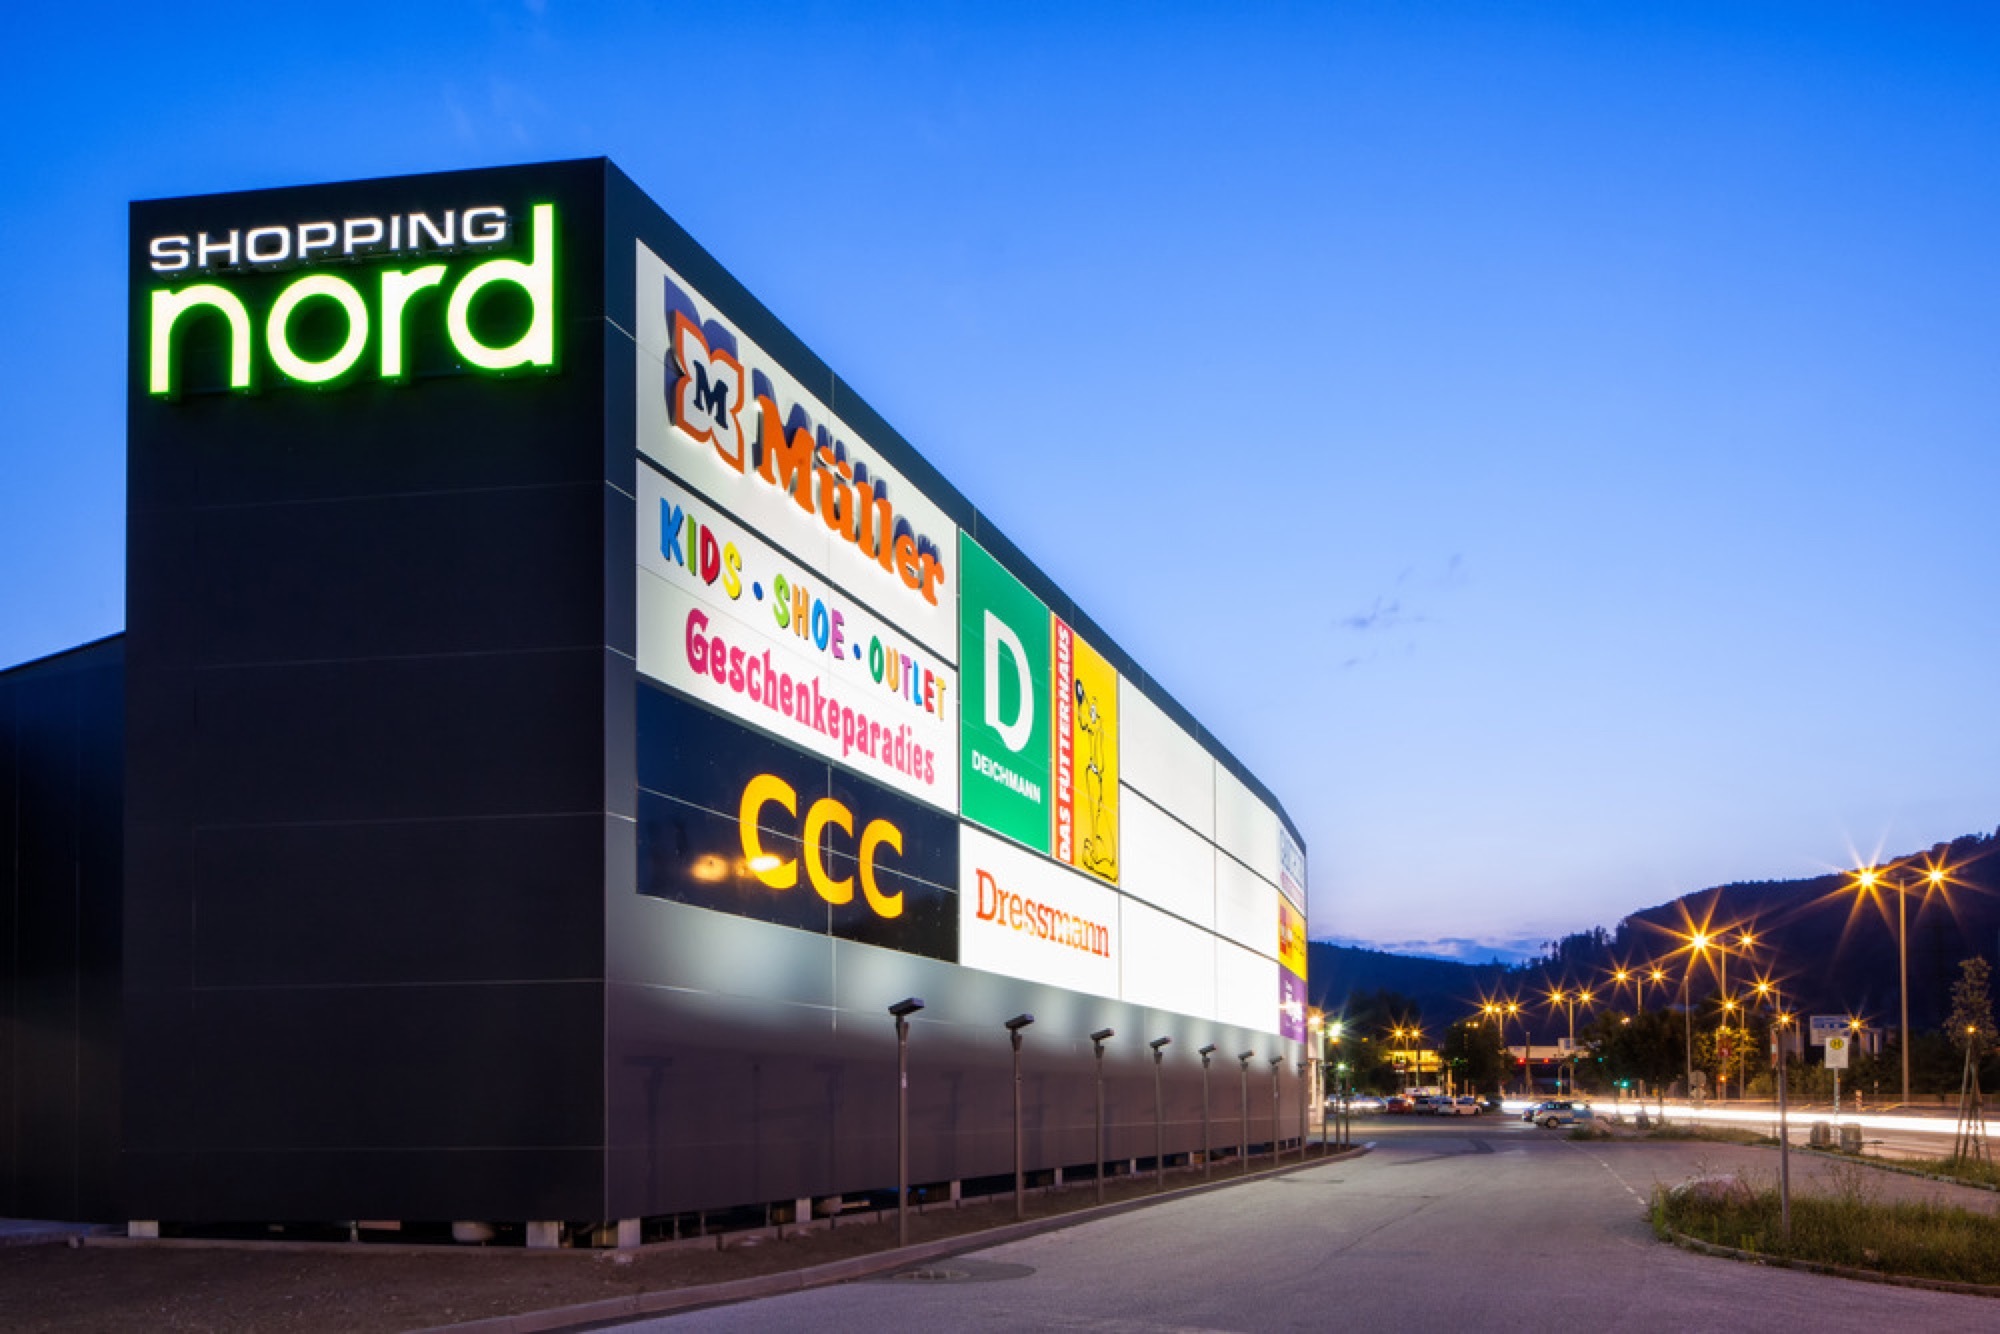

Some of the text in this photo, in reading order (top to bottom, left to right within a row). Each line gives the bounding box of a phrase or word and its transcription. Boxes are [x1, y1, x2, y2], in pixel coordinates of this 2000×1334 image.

[149, 206, 507, 271] SHOPPING
[149, 203, 555, 394] nord
[756, 394, 945, 606] Müller
[659, 497, 947, 721] KIDS SHOE OUTLET
[984, 609, 1034, 753] D
[685, 608, 935, 786] Geschenkeparadies
[972, 750, 1041, 804] DEICHMANN
[1057, 624, 1071, 863] DAS FUTTERHAUS
[739, 773, 904, 919] CCC
[976, 868, 1110, 958] Dressmann
